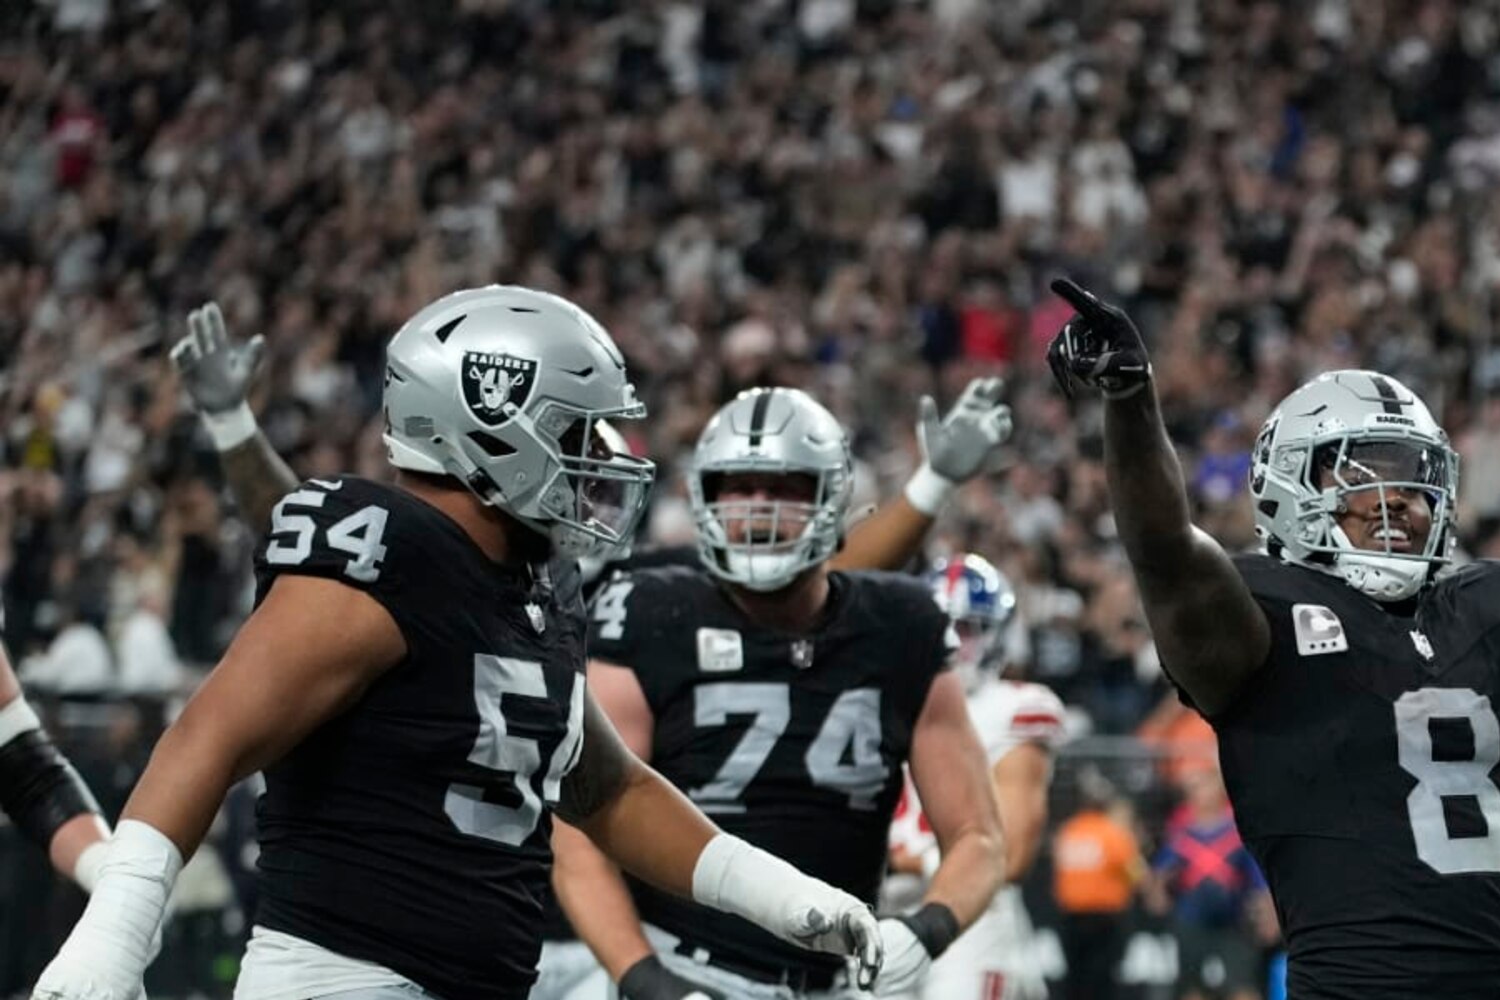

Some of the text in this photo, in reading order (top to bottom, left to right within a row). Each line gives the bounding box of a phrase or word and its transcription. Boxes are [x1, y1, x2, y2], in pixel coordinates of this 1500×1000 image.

[469, 353, 530, 371] RAIDERS
[265, 487, 389, 583] 54
[587, 581, 635, 639] 4
[689, 681, 890, 814] 74
